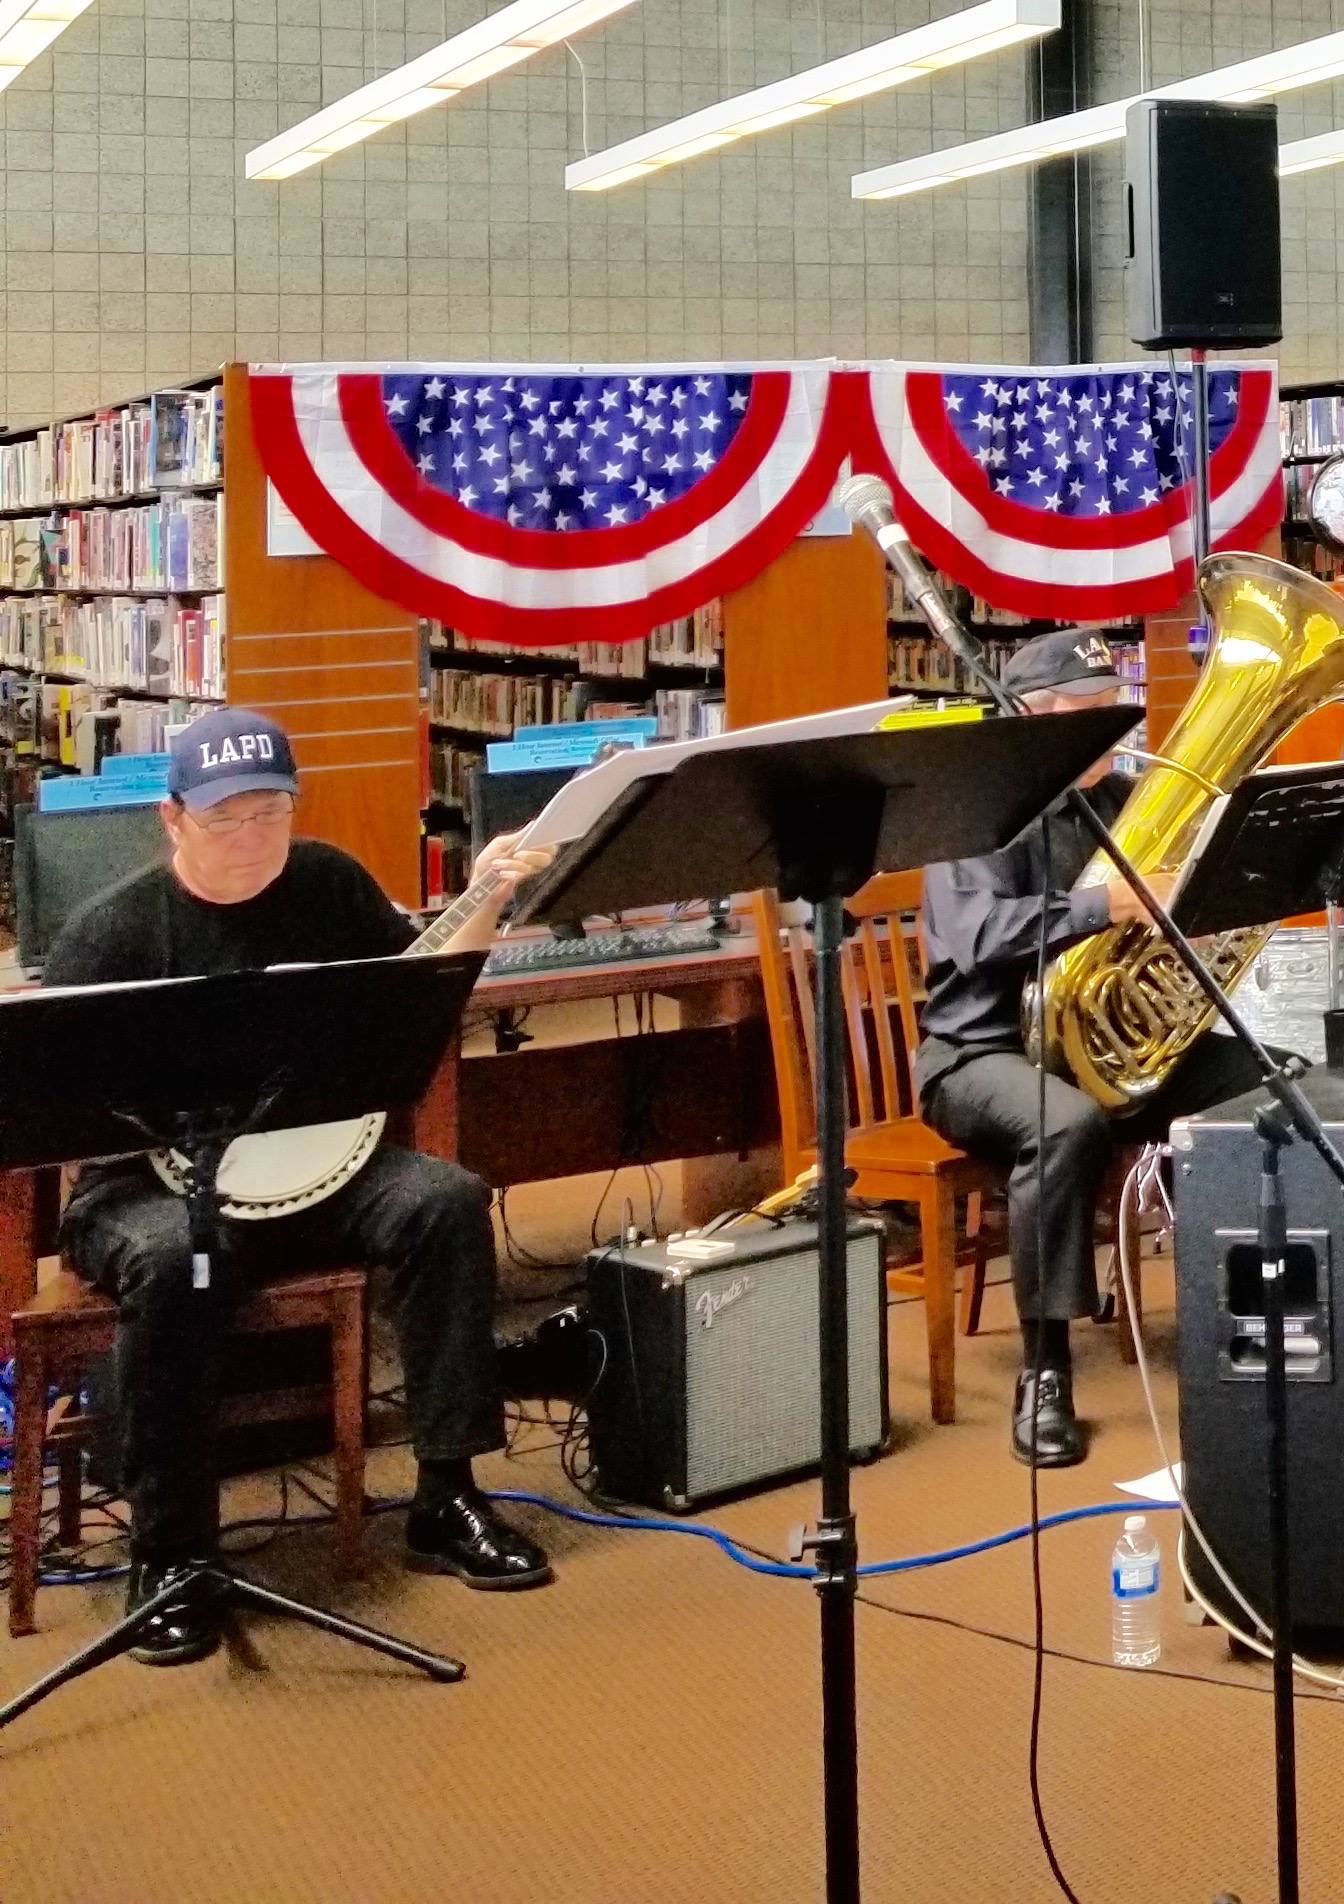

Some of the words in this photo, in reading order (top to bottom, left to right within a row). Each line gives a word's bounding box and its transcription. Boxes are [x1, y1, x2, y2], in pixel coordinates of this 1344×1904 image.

[199, 733, 274, 769] LAPD
[694, 1276, 751, 1329] Fender
[1245, 1323, 1303, 1333] BEHGER
